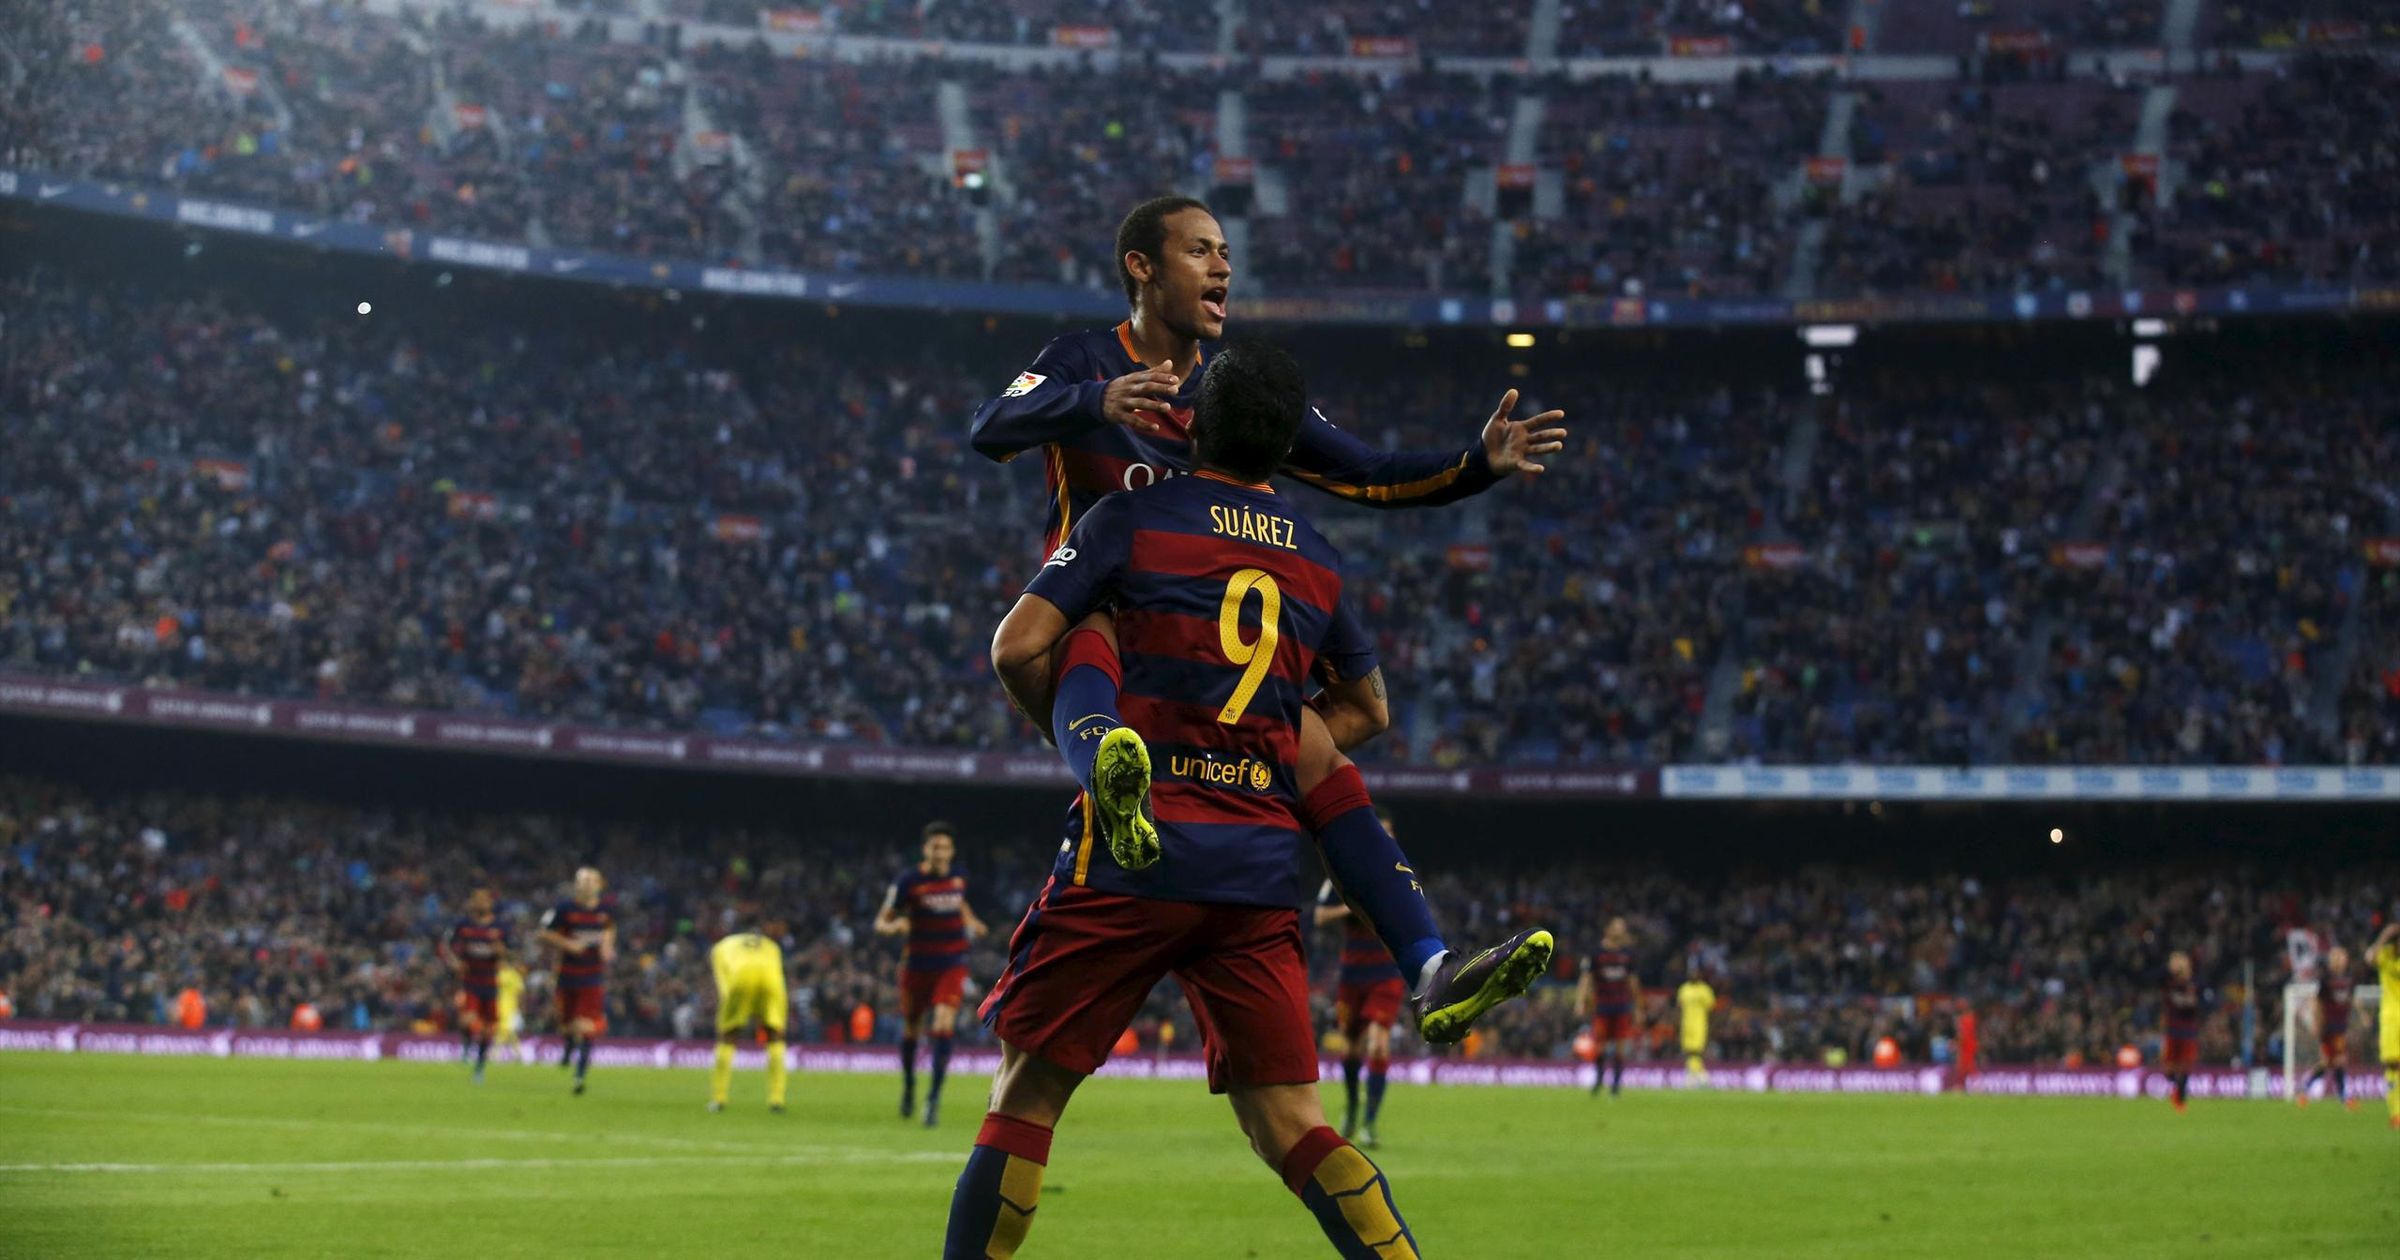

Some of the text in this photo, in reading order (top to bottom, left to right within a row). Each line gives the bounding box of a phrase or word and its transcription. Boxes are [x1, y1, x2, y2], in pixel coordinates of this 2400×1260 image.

[1210, 505, 1297, 550] SUÁREZ
[1217, 568, 1281, 725] 9
[1171, 753, 1250, 785] unicef
